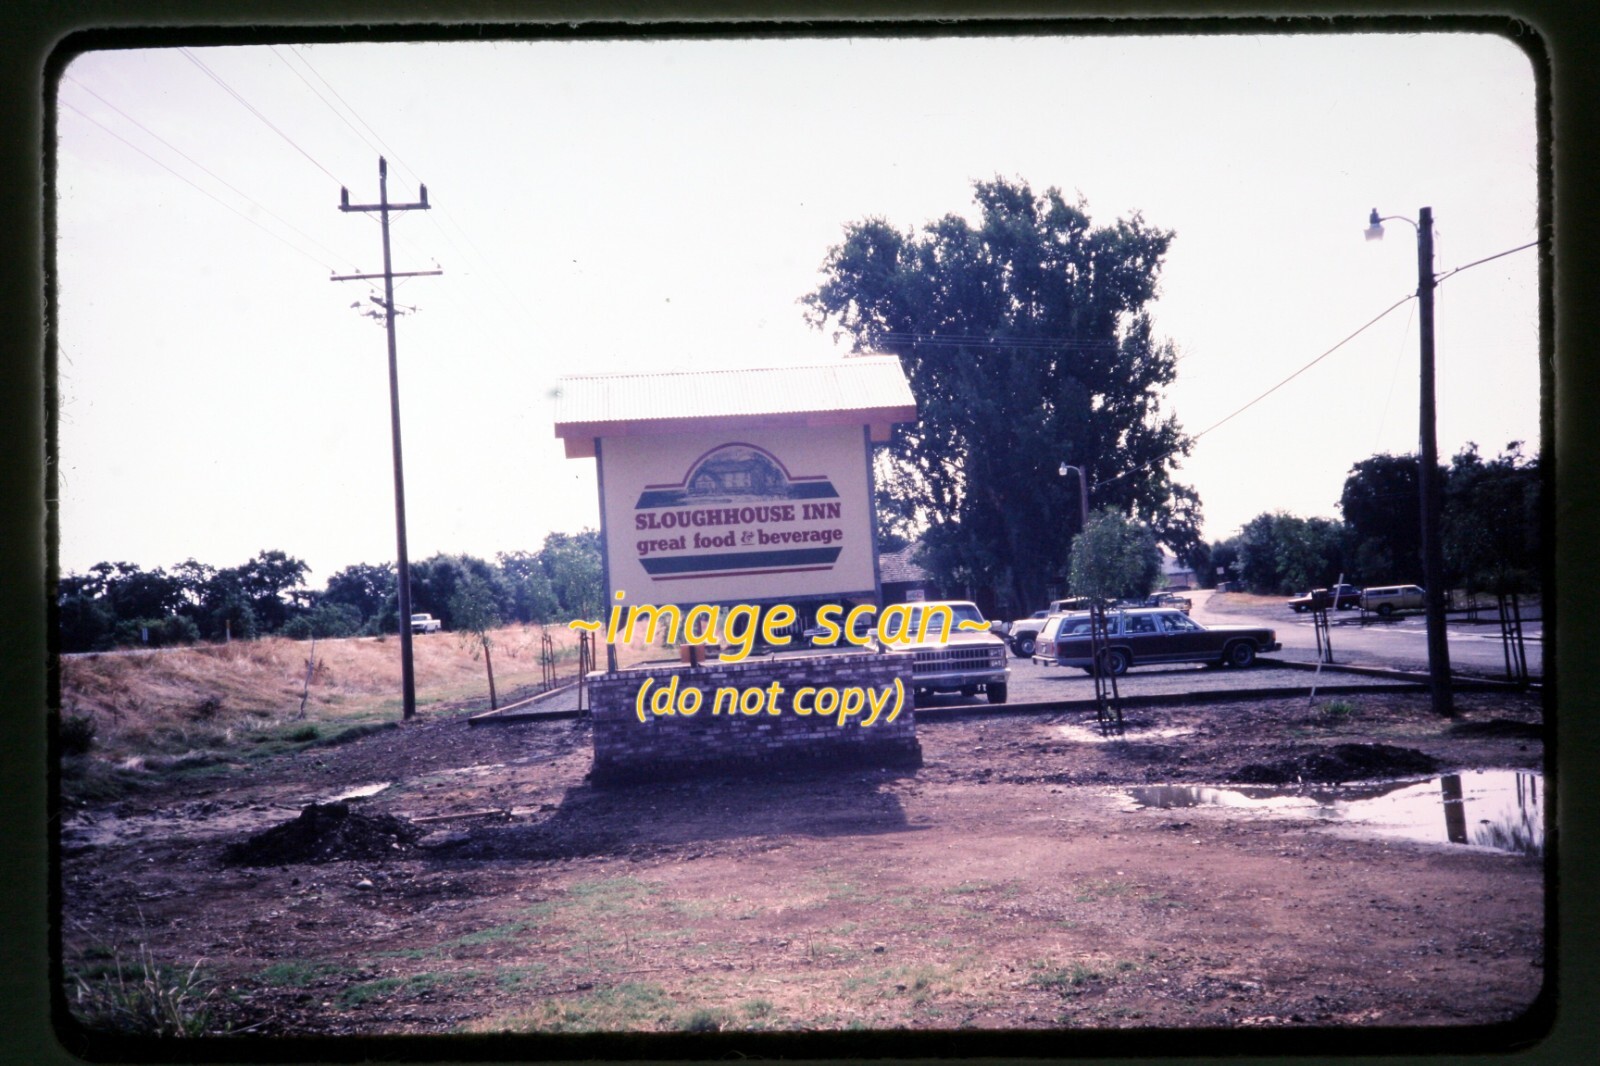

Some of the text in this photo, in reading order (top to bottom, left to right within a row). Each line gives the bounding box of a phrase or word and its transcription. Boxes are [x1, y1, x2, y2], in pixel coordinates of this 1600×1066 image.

[635, 502, 841, 531] SLOUGHHOUSE INN
[637, 527, 843, 555] great food & beverage
